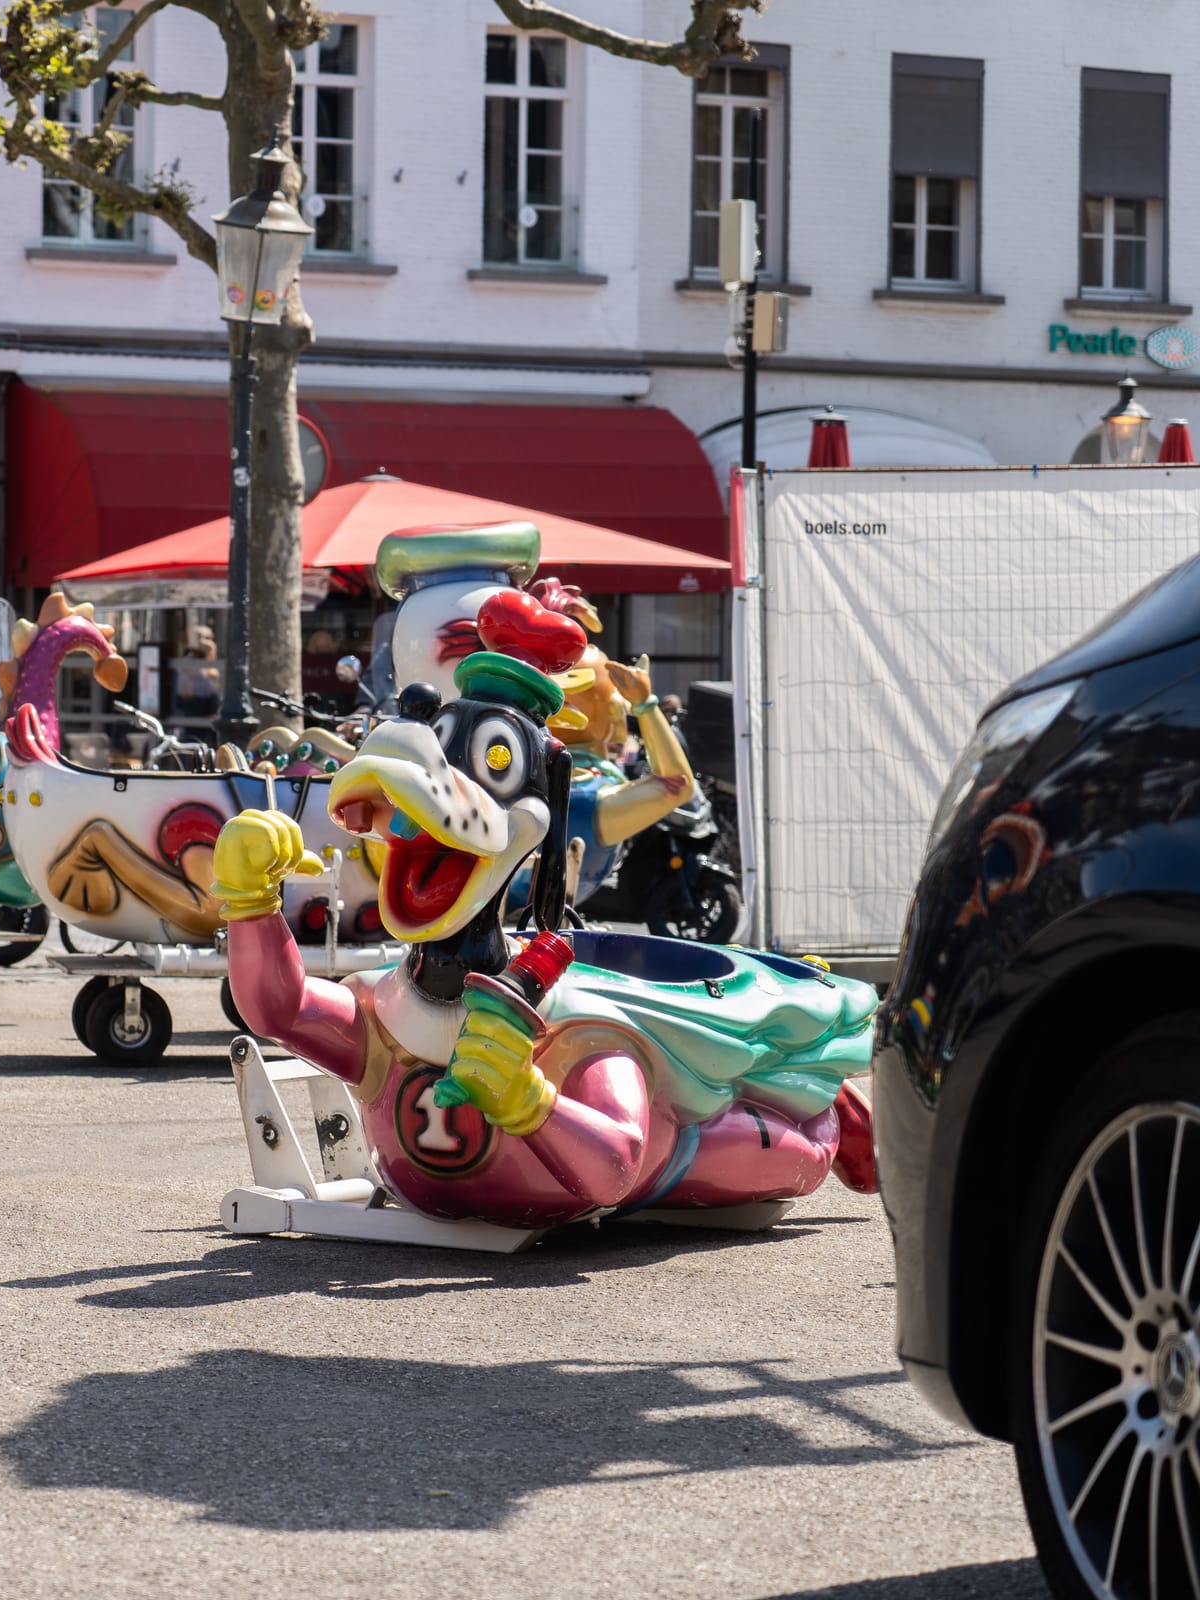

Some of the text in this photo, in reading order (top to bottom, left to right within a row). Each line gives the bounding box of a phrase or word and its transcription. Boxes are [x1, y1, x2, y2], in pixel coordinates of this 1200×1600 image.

[1049, 323, 1137, 356] Pearle
[805, 519, 887, 536] boels.com
[231, 1201, 238, 1223] 1
